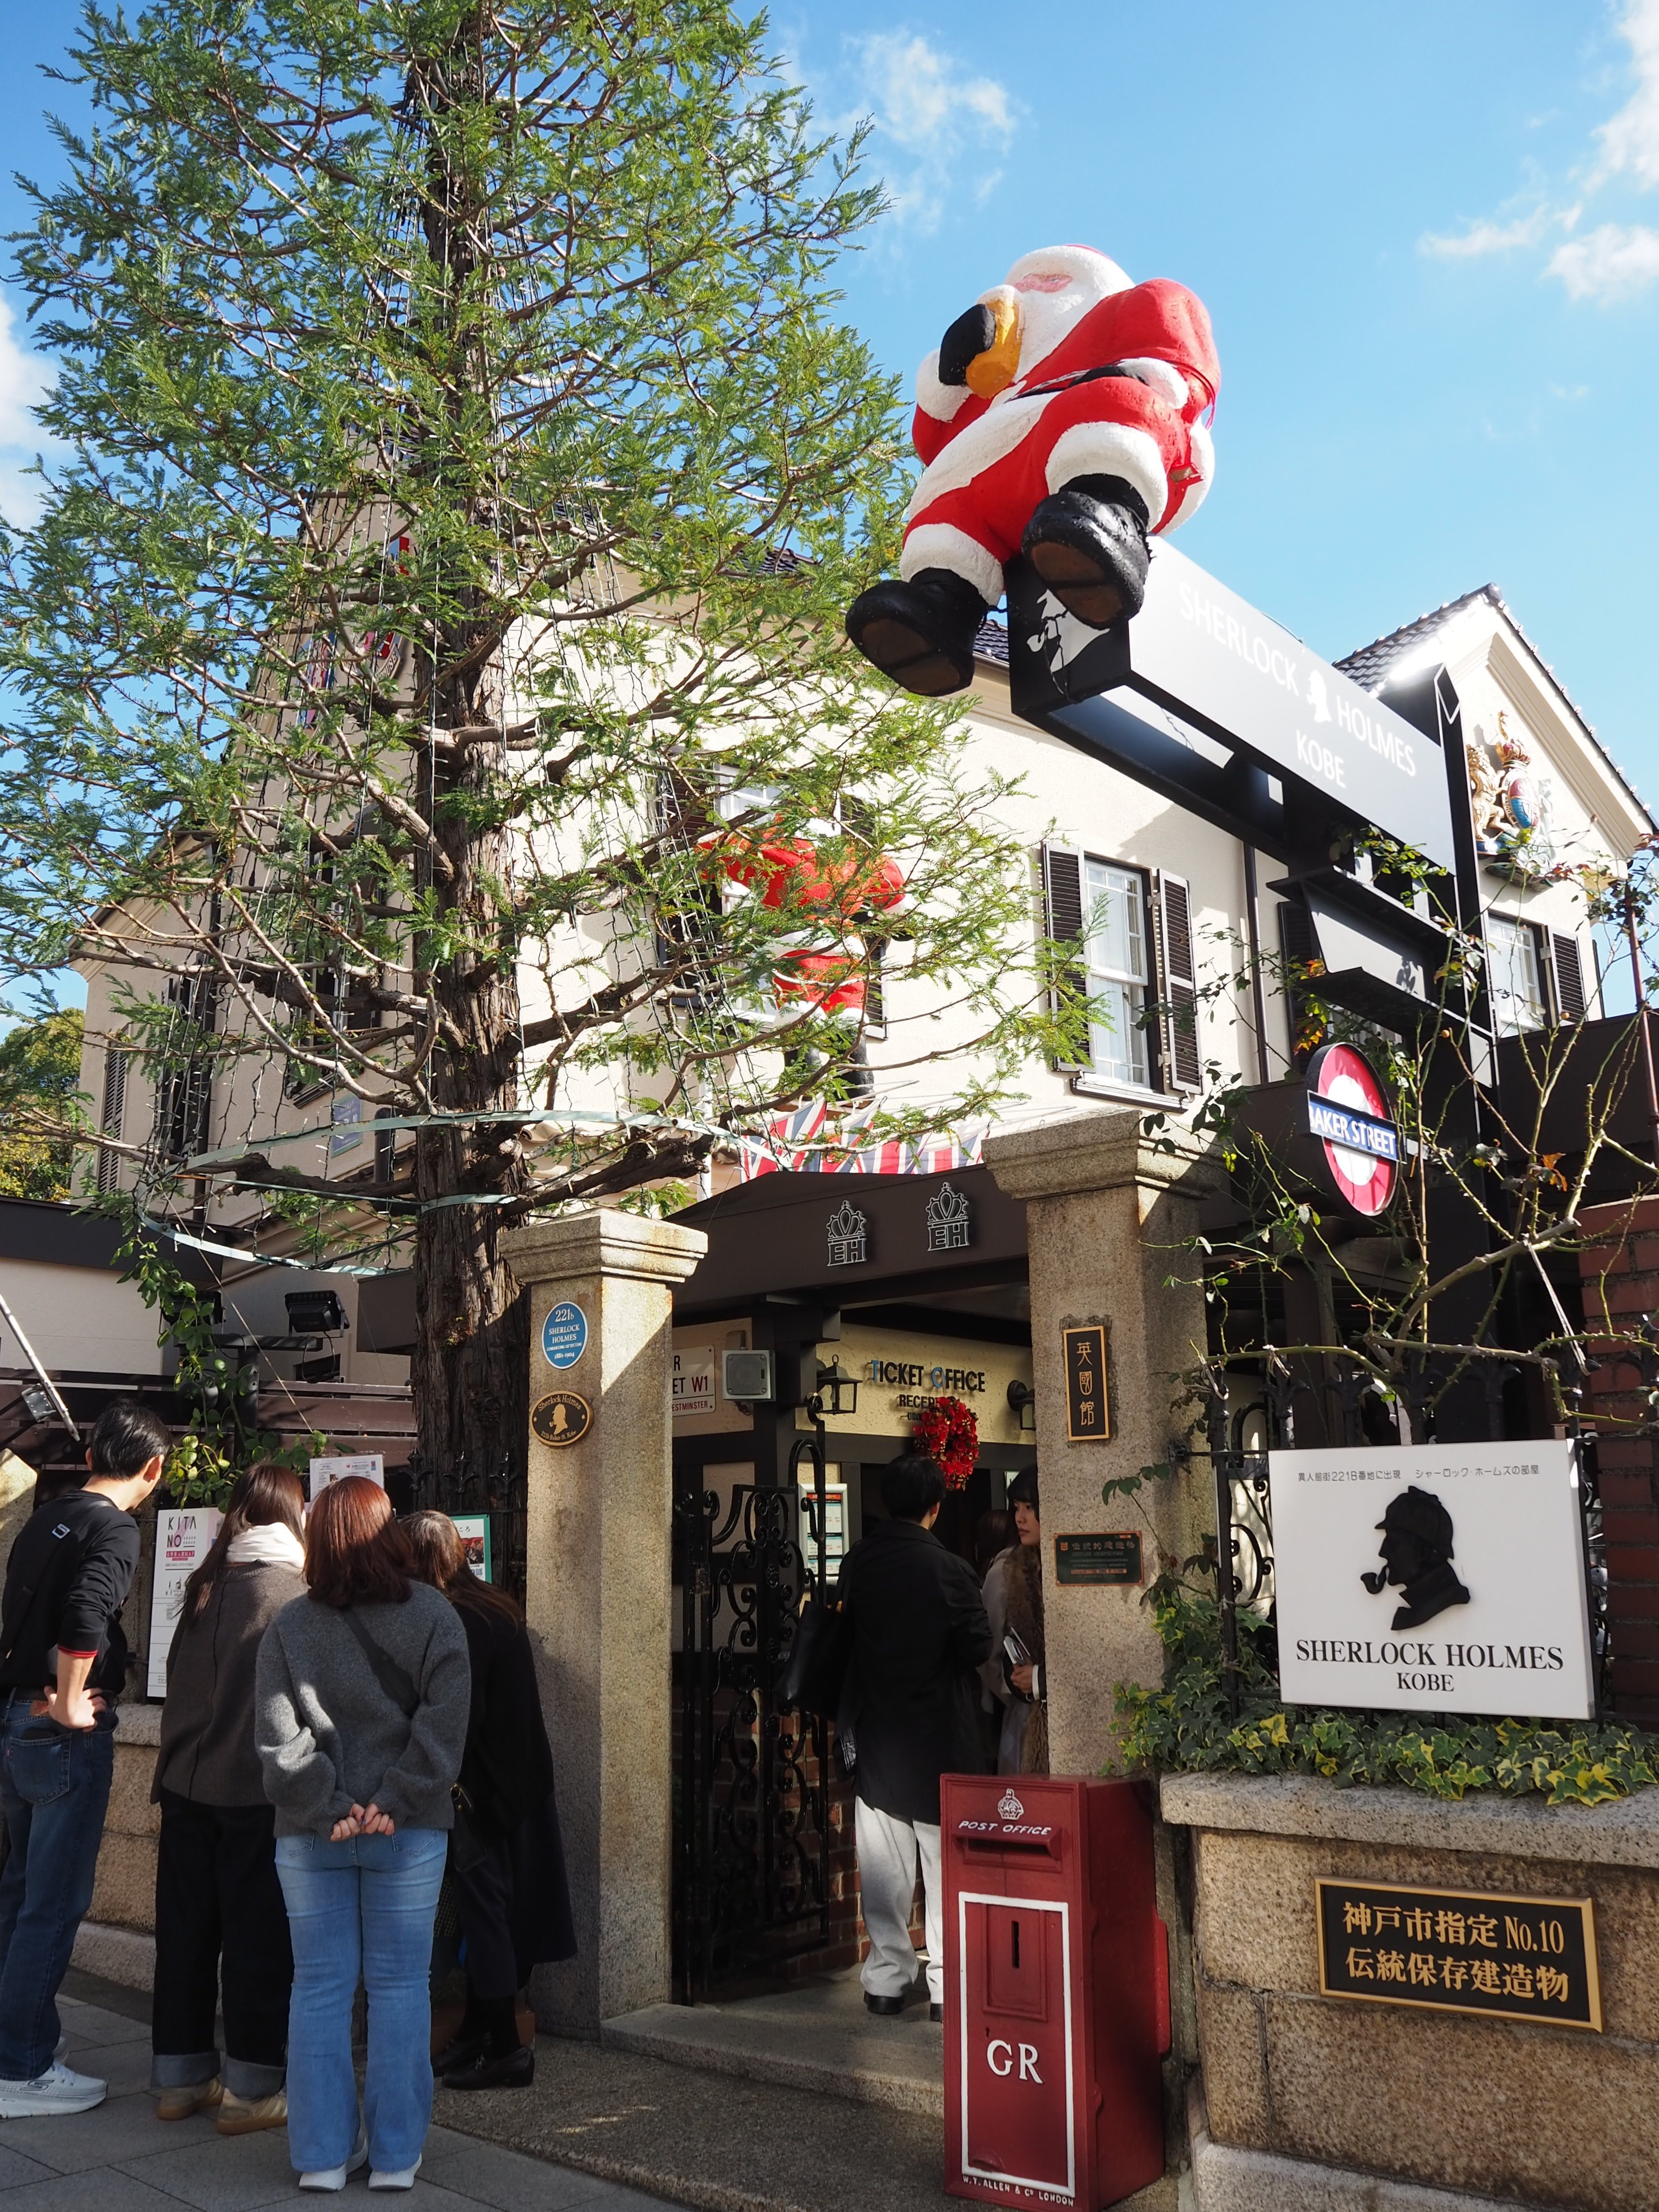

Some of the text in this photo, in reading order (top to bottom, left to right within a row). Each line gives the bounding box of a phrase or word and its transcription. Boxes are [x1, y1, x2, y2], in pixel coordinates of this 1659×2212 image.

[1179, 582, 1415, 777] SHERLOCK HOLMES
[1296, 730, 1346, 788] KOBE
[1309, 1105, 1396, 1155] BAKER STREET
[549, 1324, 580, 1335] SHERLOCK
[552, 1334, 577, 1344] HOLMES
[691, 1375, 708, 1392] W1
[871, 1360, 985, 1392] TICKET OFFICE
[1076, 1341, 1095, 1426] 英國館
[538, 1395, 581, 1412] Sherlock Holmes
[899, 1394, 938, 1409] RECEP
[1298, 1465, 1539, 1482] 異人館街221B番地に出現 シャーロック・ホームズの部屋
[168, 1516, 196, 1530] KITA
[167, 1535, 181, 1548] NO
[1296, 1639, 1564, 1670] SHERLOCK HOLMES
[1397, 1672, 1454, 1692] KOBE
[958, 1820, 1052, 1835] POST OFFICE
[1342, 1902, 1565, 1954] 神戸市指定 No.10
[1345, 1947, 1569, 2003] 伝統保存建造物
[987, 2040, 1043, 2084] GR
[983, 2179, 1010, 2193] ALLEN
[1015, 2185, 1020, 2195] &
[1039, 2191, 1074, 2207] LONDON
